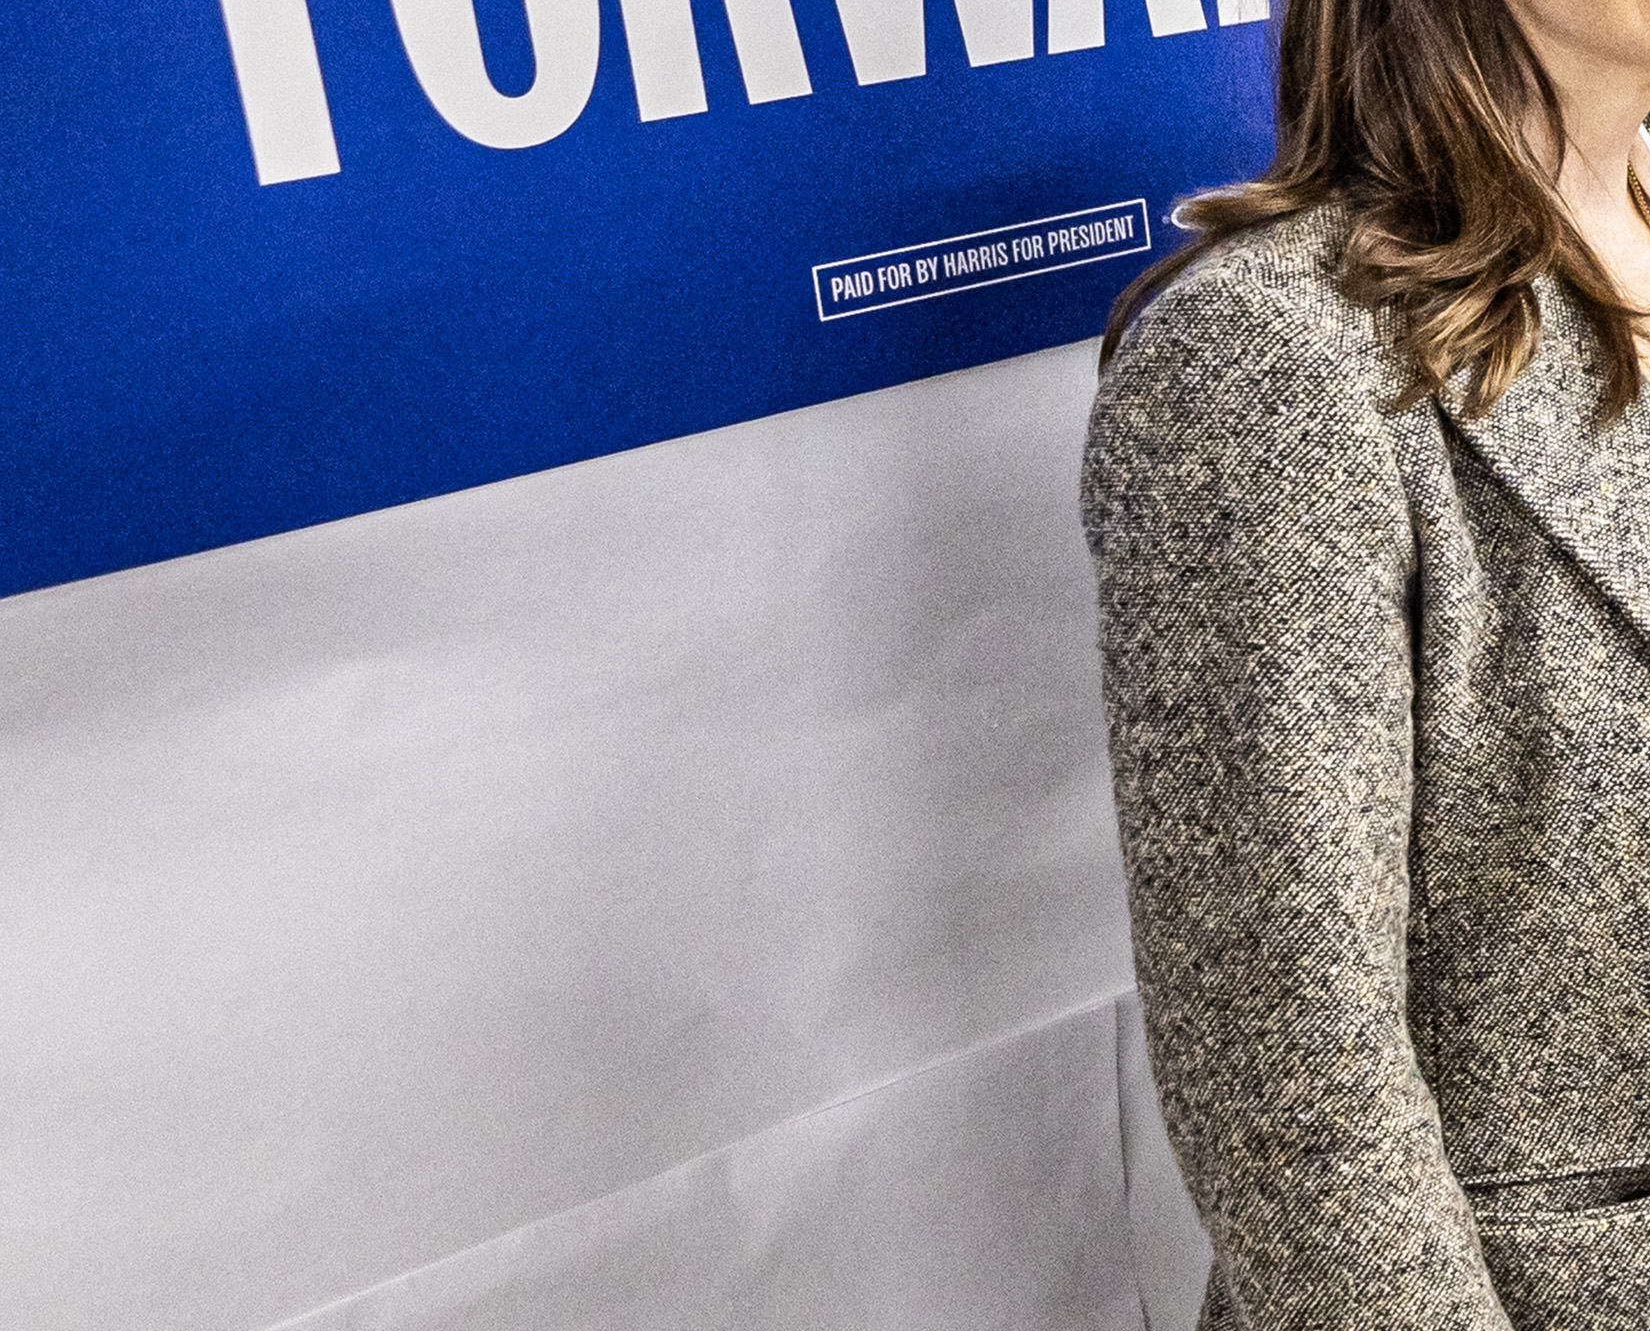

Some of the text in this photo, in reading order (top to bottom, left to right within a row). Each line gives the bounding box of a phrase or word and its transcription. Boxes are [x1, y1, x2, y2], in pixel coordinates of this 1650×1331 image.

[831, 215, 1136, 302] PAID FOR BY HARRIS FOR PRESIDENT
